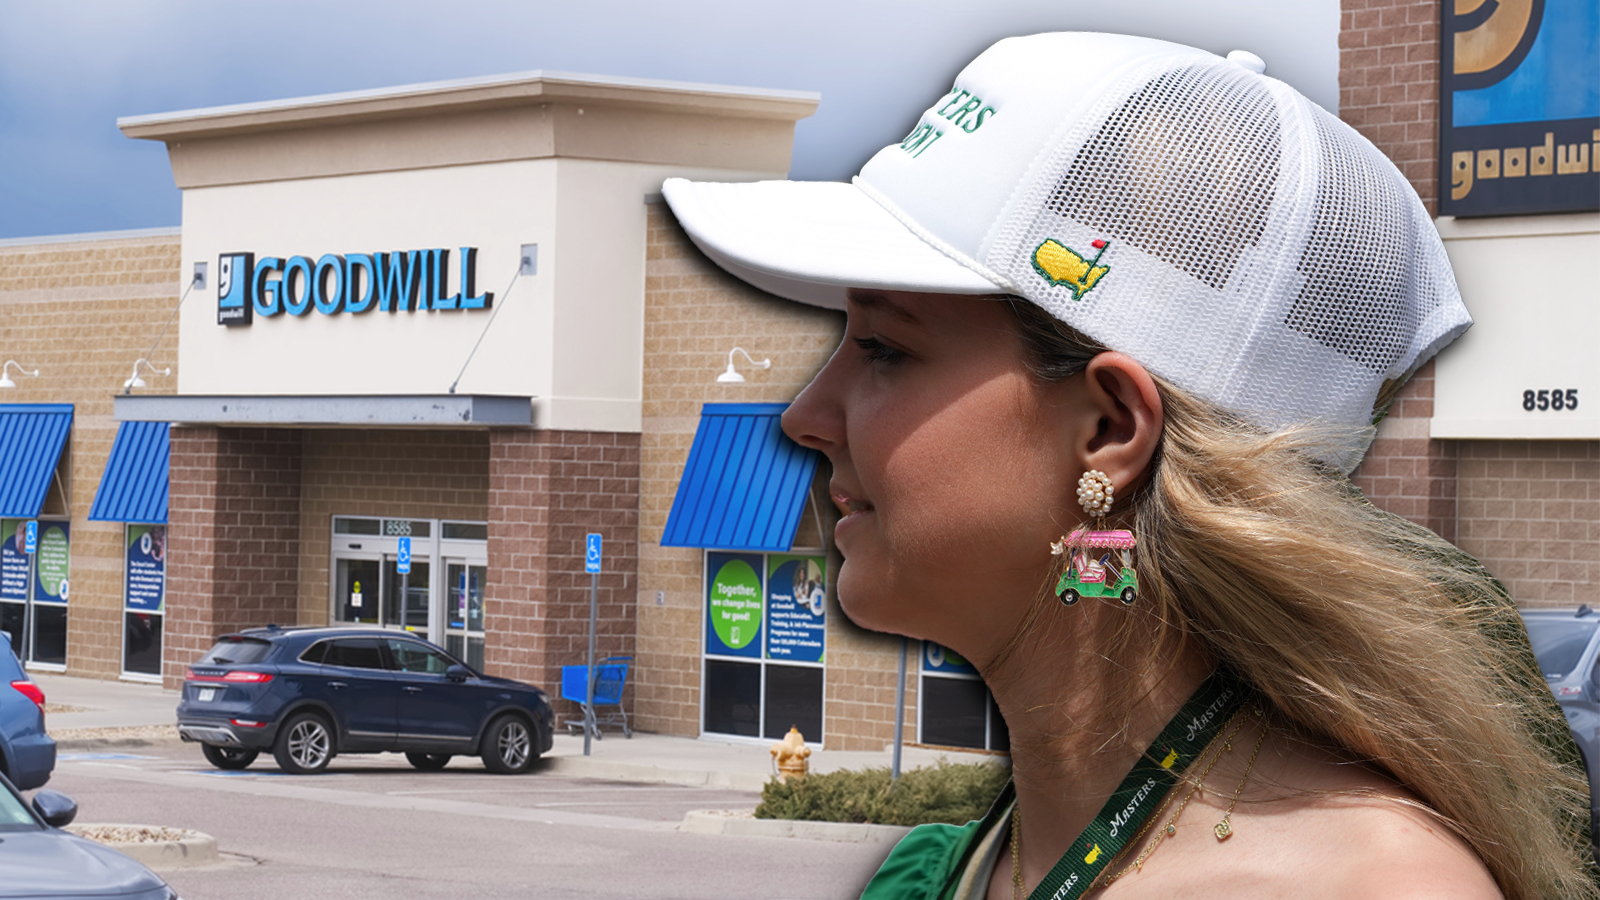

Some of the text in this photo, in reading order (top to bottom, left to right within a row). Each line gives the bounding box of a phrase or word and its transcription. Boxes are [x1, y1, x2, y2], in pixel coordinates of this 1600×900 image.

[252, 247, 493, 317] GOODWILL
[1522, 388, 1578, 412] 8585
[386, 520, 412, 535] 8585
[717, 583, 757, 598] Together,
[722, 598, 745, 610] change
[746, 599, 761, 609] lives
[722, 610, 751, 621] for good!
[1110, 777, 1156, 837] MASTERS
[1051, 872, 1079, 900] TERS
